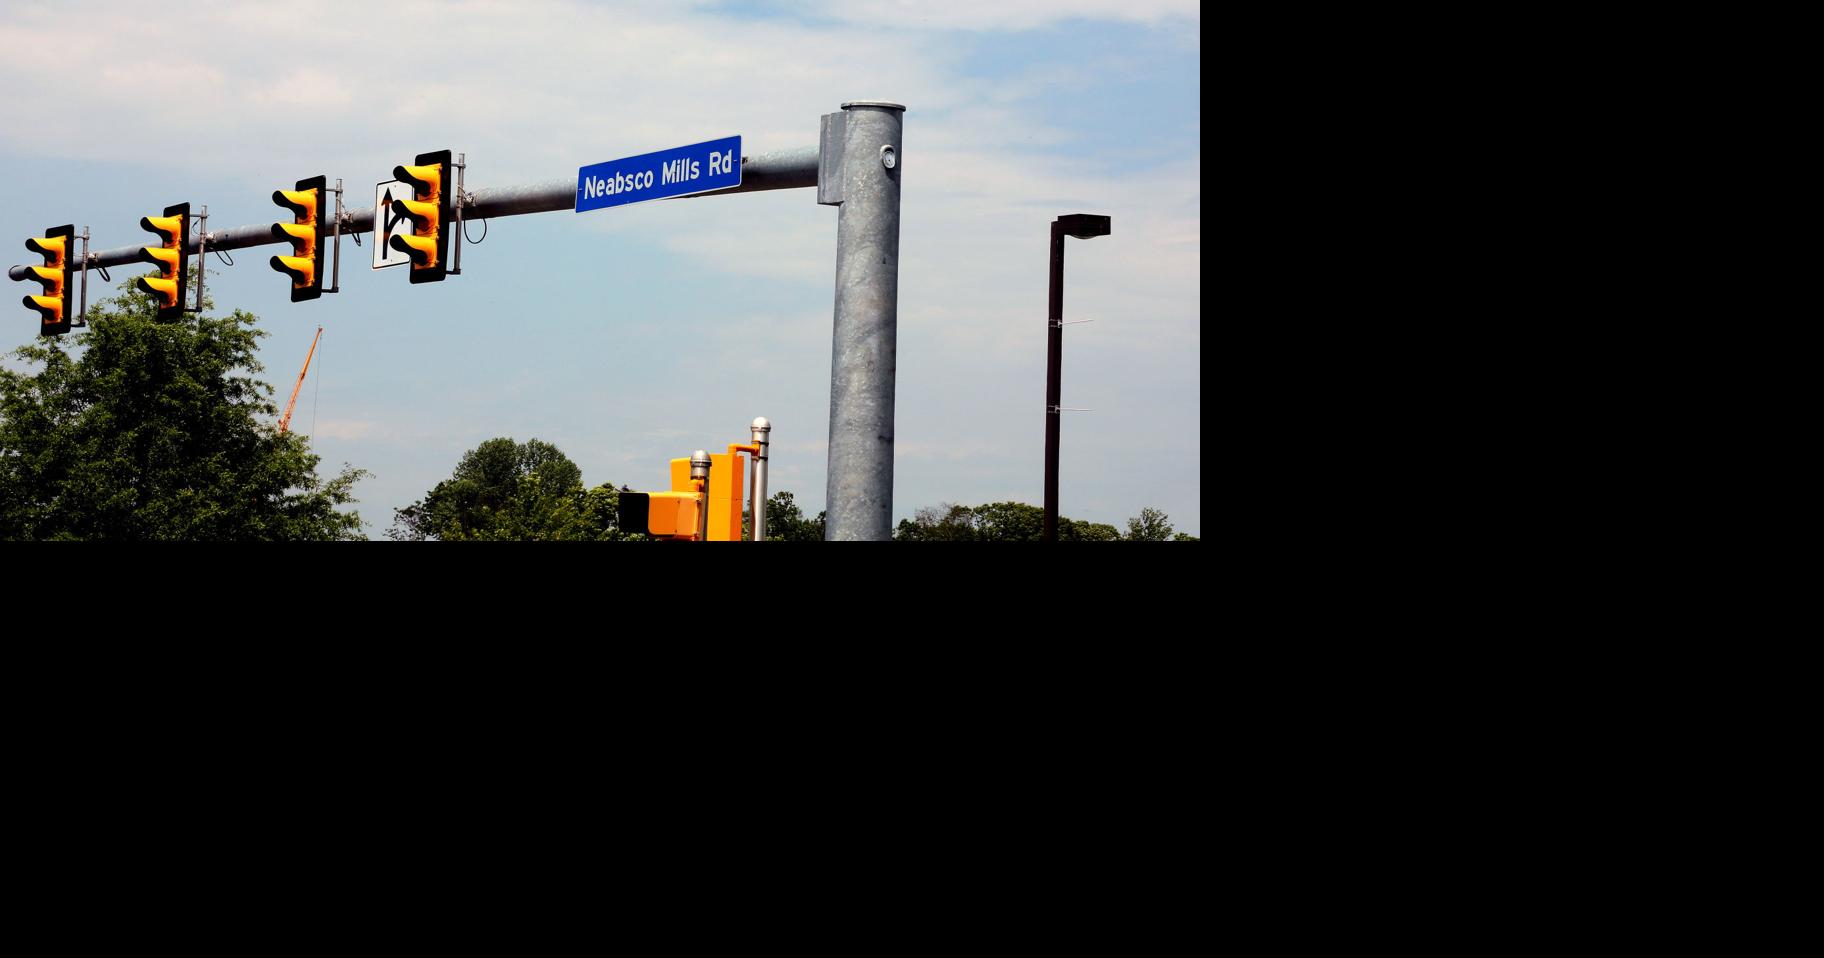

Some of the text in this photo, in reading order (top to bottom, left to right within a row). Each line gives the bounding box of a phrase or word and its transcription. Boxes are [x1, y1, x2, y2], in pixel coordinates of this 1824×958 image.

[584, 149, 733, 200] Neabsco Mills Rd
